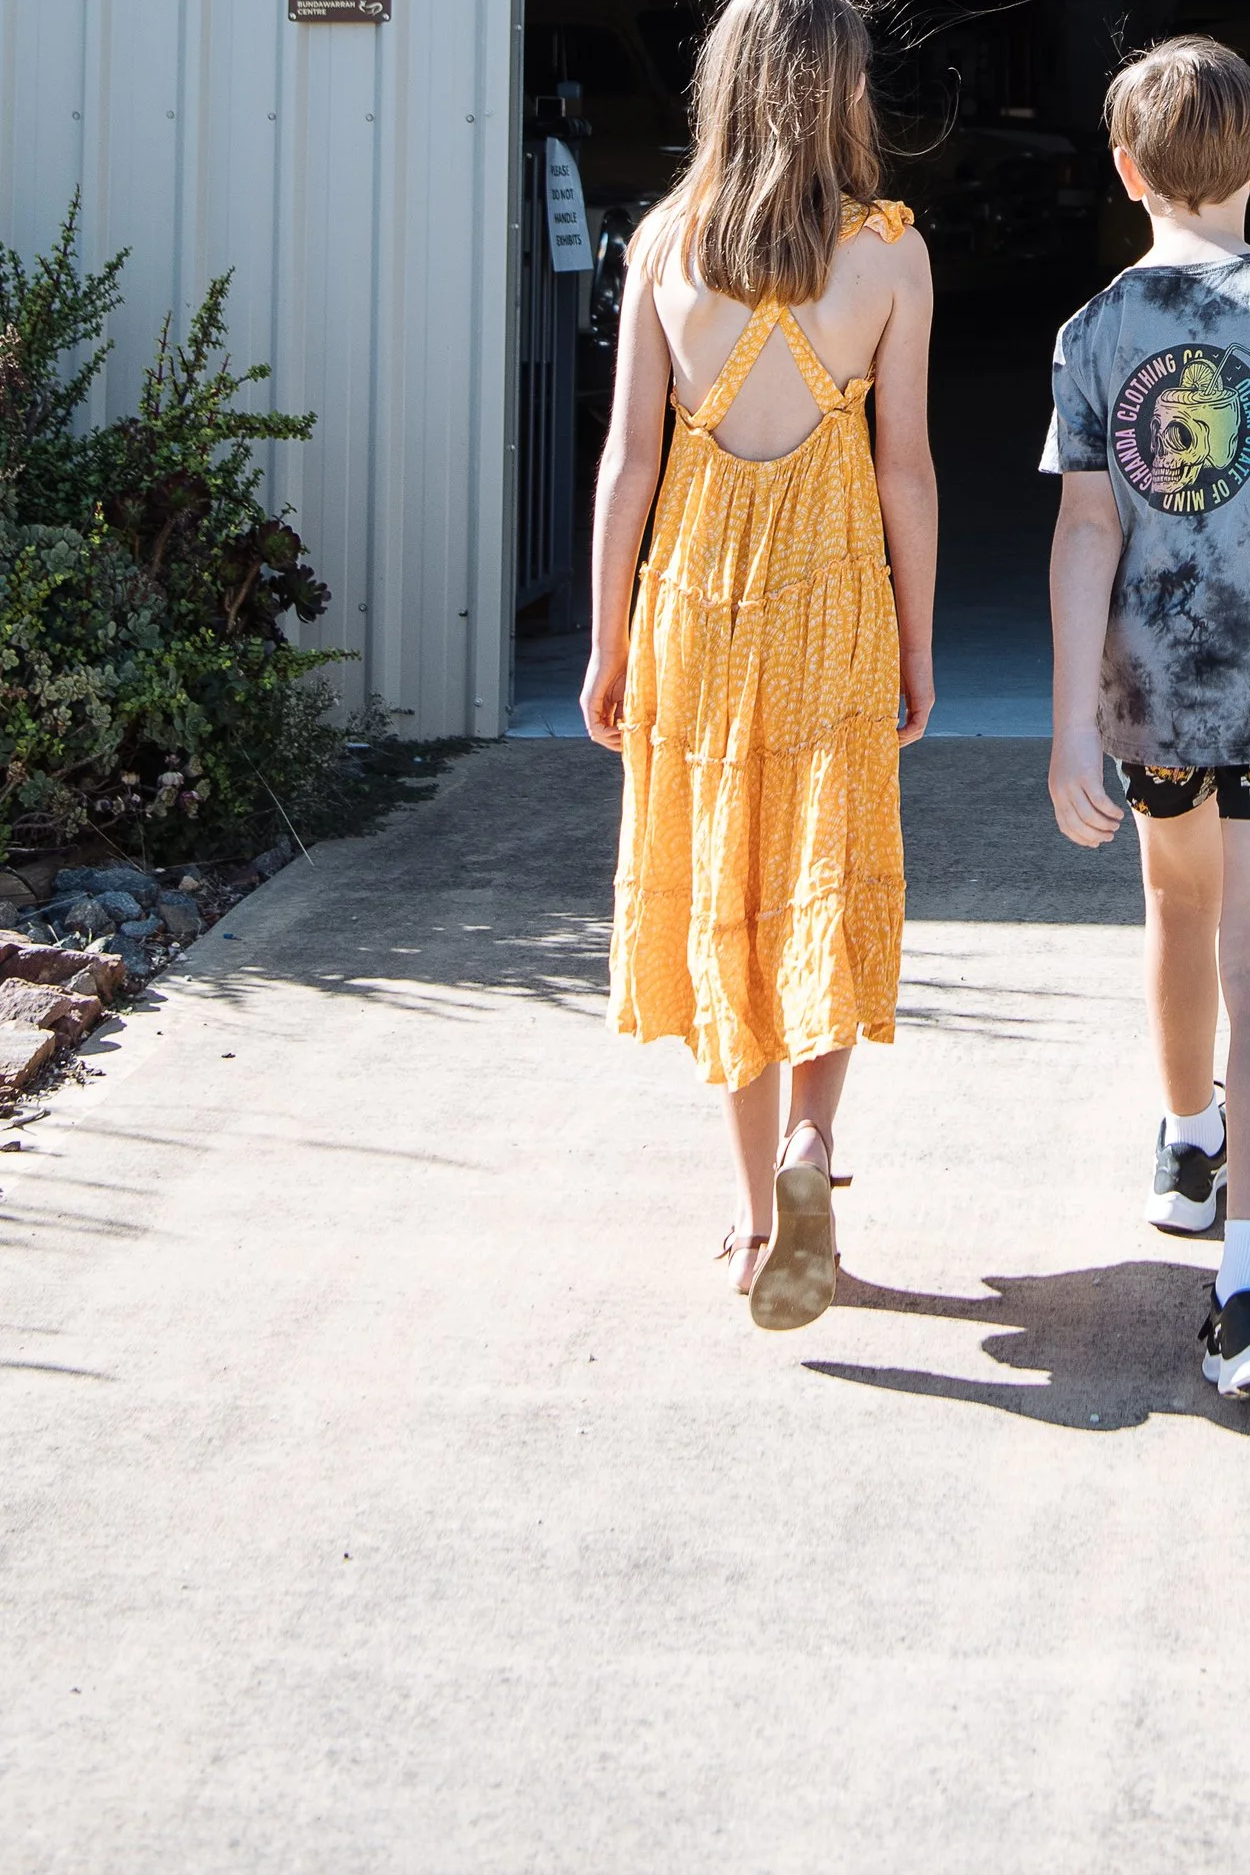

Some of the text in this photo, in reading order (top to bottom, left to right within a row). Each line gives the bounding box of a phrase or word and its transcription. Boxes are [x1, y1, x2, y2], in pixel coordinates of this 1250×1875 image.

[297, 0, 355, 8] BUNDAWARRAN
[551, 165, 570, 177] PLEASE
[552, 188, 574, 200] DO NOT
[553, 212, 577, 224] HANDLE
[556, 234, 582, 246] EXHIBITS
[1117, 353, 1177, 423] CLOTHING
[1115, 427, 1152, 491] GHANDA
[1211, 478, 1230, 504] OF
[1163, 489, 1205, 512] MIND
